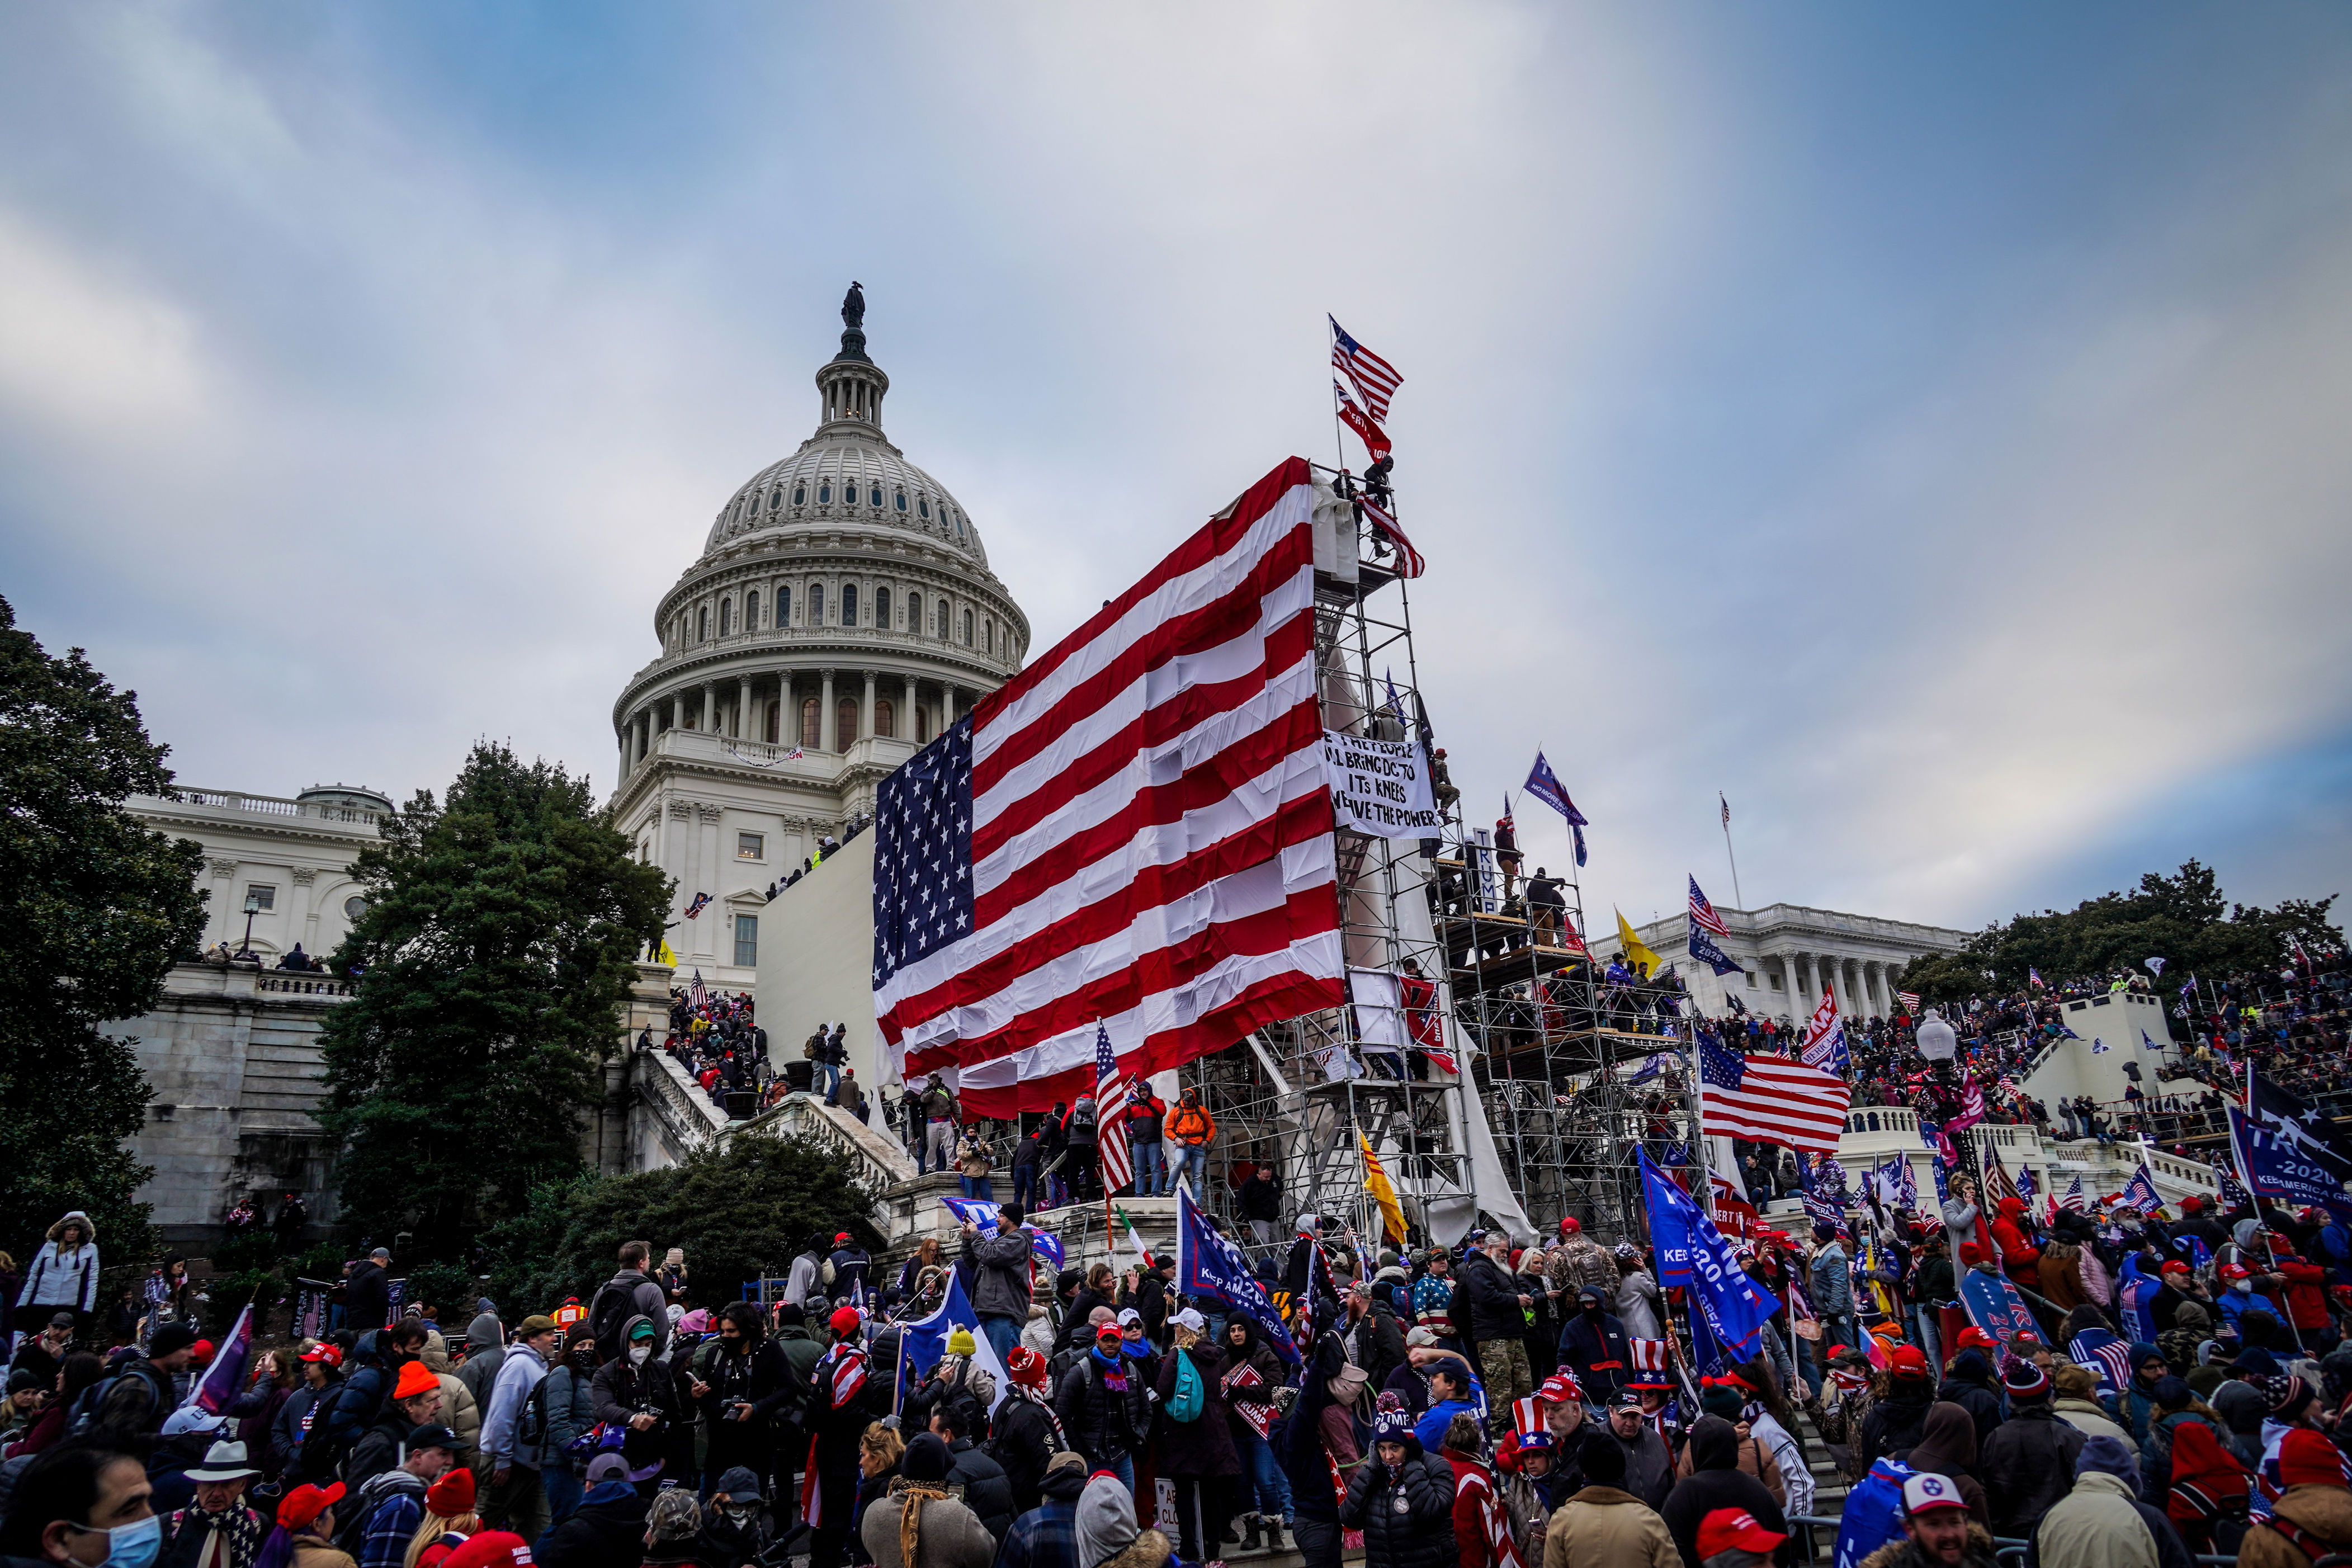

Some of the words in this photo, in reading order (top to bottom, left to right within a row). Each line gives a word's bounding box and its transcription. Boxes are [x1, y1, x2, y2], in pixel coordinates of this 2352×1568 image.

[1399, 763, 1415, 781] TO
[1541, 789, 1560, 805] MORE
[1373, 803, 1395, 825] THE
[1395, 810, 1437, 828] POWER
[1477, 830, 1495, 914] TRUMP
[1698, 946, 1723, 962] 2020
[2280, 1179, 2329, 1197] AMERICA
